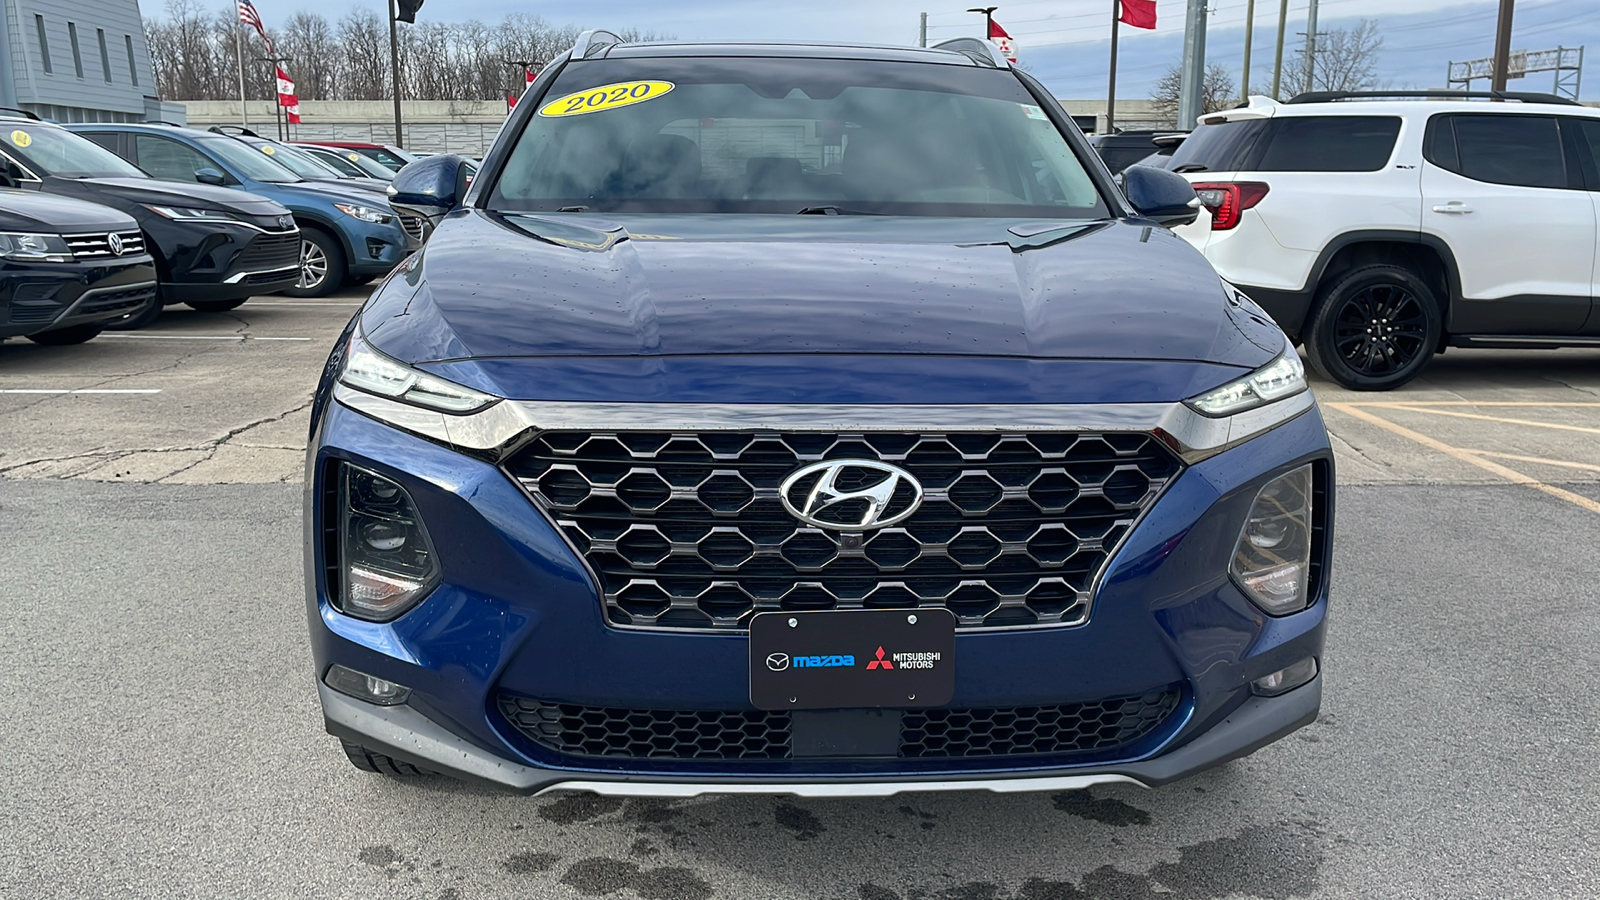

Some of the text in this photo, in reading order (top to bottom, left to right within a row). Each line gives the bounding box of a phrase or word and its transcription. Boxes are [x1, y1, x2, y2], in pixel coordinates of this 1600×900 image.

[563, 83, 651, 113] 2020
[793, 655, 855, 668] mazda
[893, 652, 941, 661] MITSUBISHI
[900, 660, 934, 670] MOTORS
